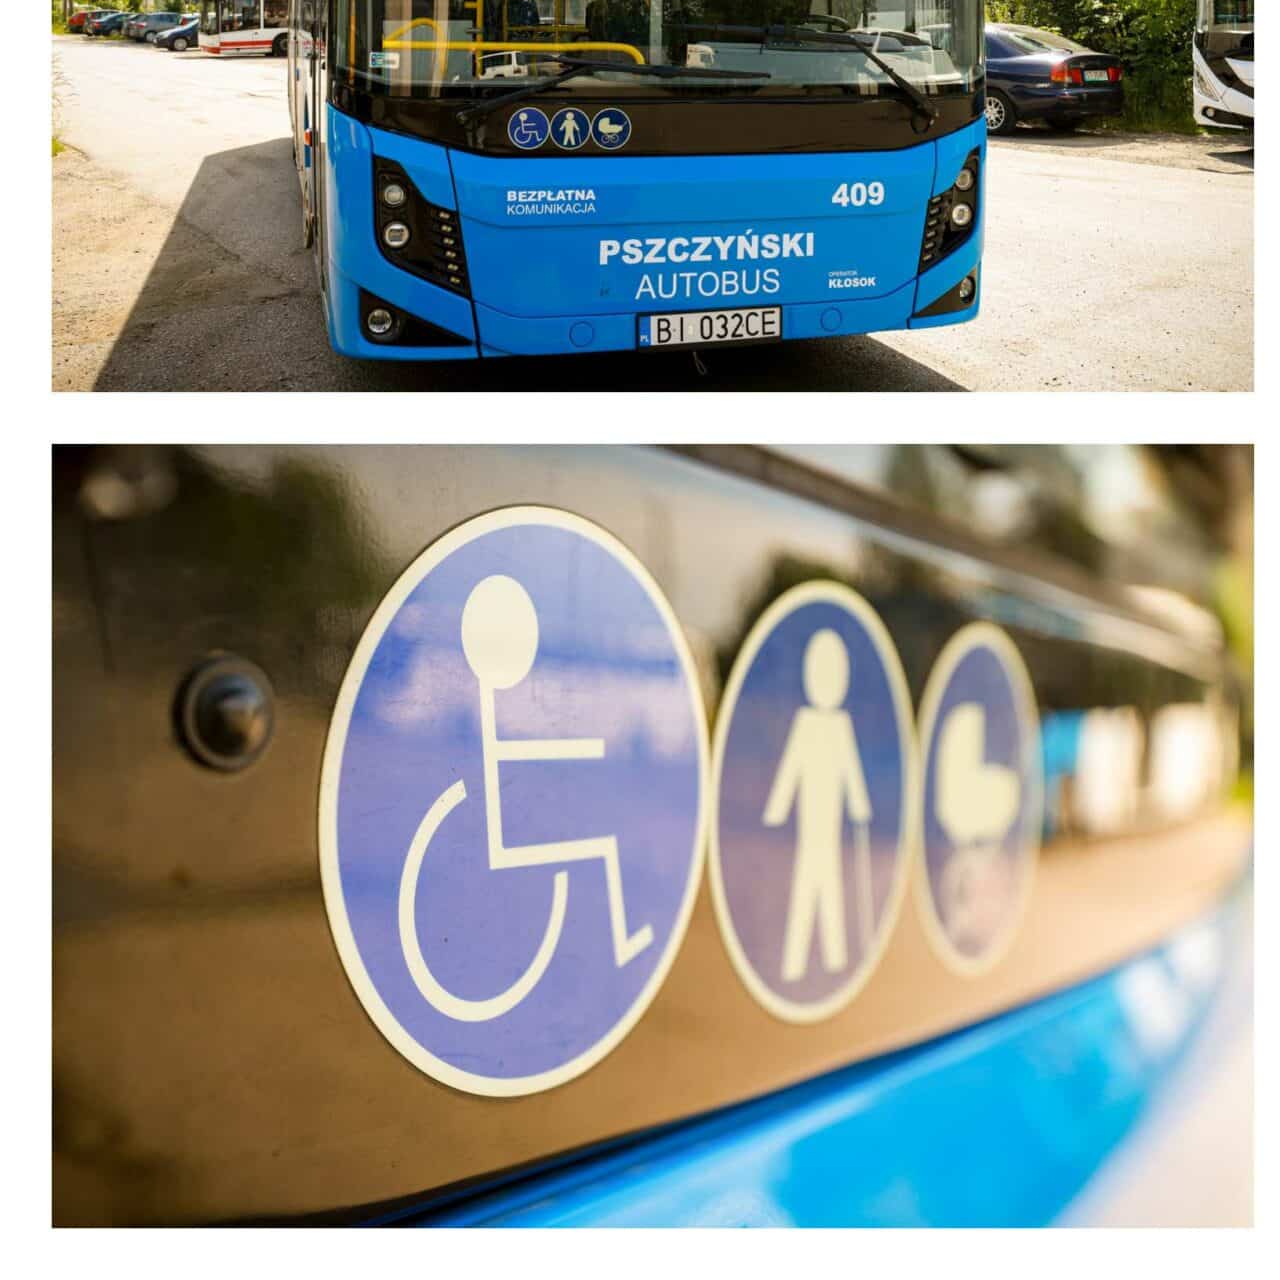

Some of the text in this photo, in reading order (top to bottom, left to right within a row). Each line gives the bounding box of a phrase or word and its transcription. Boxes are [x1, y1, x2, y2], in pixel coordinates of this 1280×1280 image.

[506, 190, 597, 202] BEZPŁATNA
[831, 182, 885, 207] 409
[506, 203, 597, 216] KOMUNIKACJA
[599, 229, 814, 265] PSZCZYŃSKI
[635, 269, 780, 301] AUTOBUS
[828, 277, 876, 289] KŁOSOK
[657, 310, 776, 344] BI 032CE
